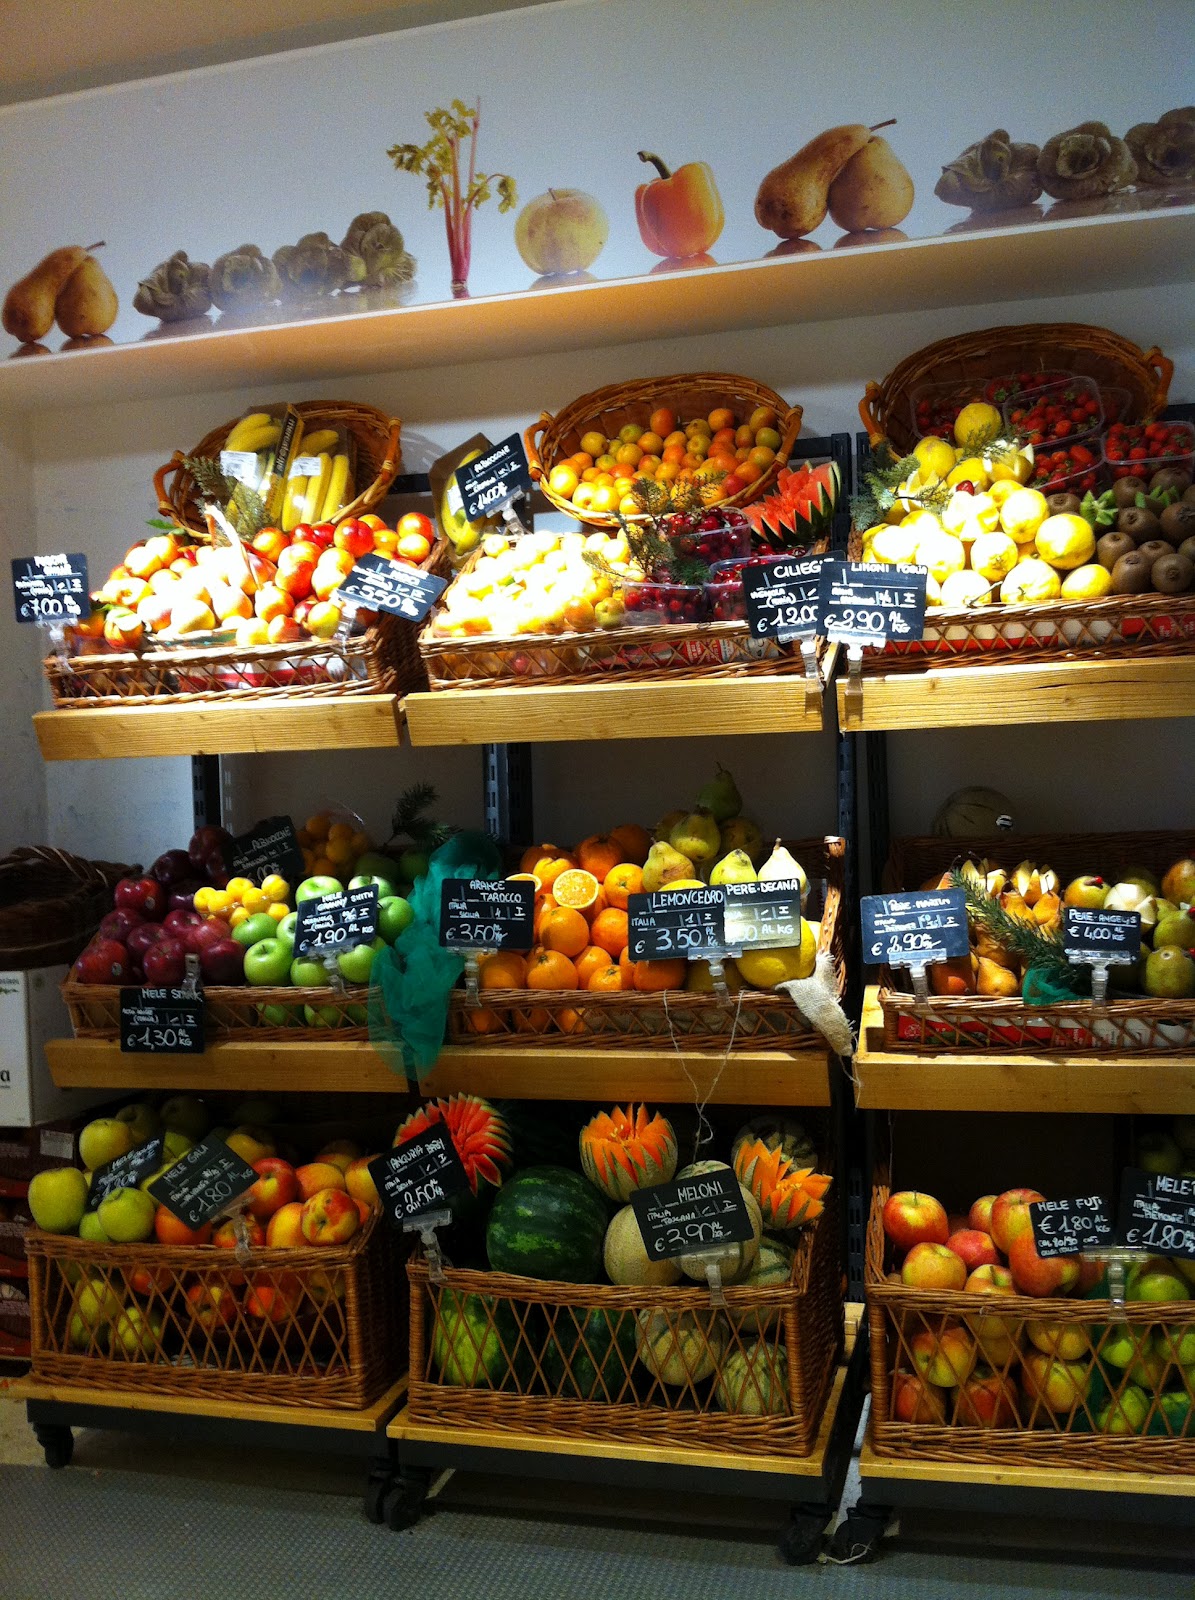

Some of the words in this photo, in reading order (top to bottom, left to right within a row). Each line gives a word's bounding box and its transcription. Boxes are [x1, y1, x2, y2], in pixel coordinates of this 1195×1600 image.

[470, 880, 505, 891] ARANCE
[480, 893, 522, 904] TAROCCO
[653, 890, 723, 908] LEMONCEDRO
[631, 917, 656, 926] ITALIA
[1067, 926, 1080, 938] €
[635, 940, 645, 953] €
[871, 942, 883, 956] €
[141, 988, 167, 999] MELE
[390, 1145, 424, 1170] ANGURIA
[163, 1163, 187, 1182] MELE
[677, 1181, 723, 1203] MELONI
[1037, 1200, 1070, 1211] MELE
[1075, 1196, 1103, 1210] FUJI
[394, 1204, 404, 1219] €
[647, 1210, 671, 1221] ITALIA
[1037, 1215, 1056, 1235] €
[1126, 1229, 1140, 1243] €
[654, 1238, 665, 1252] €
